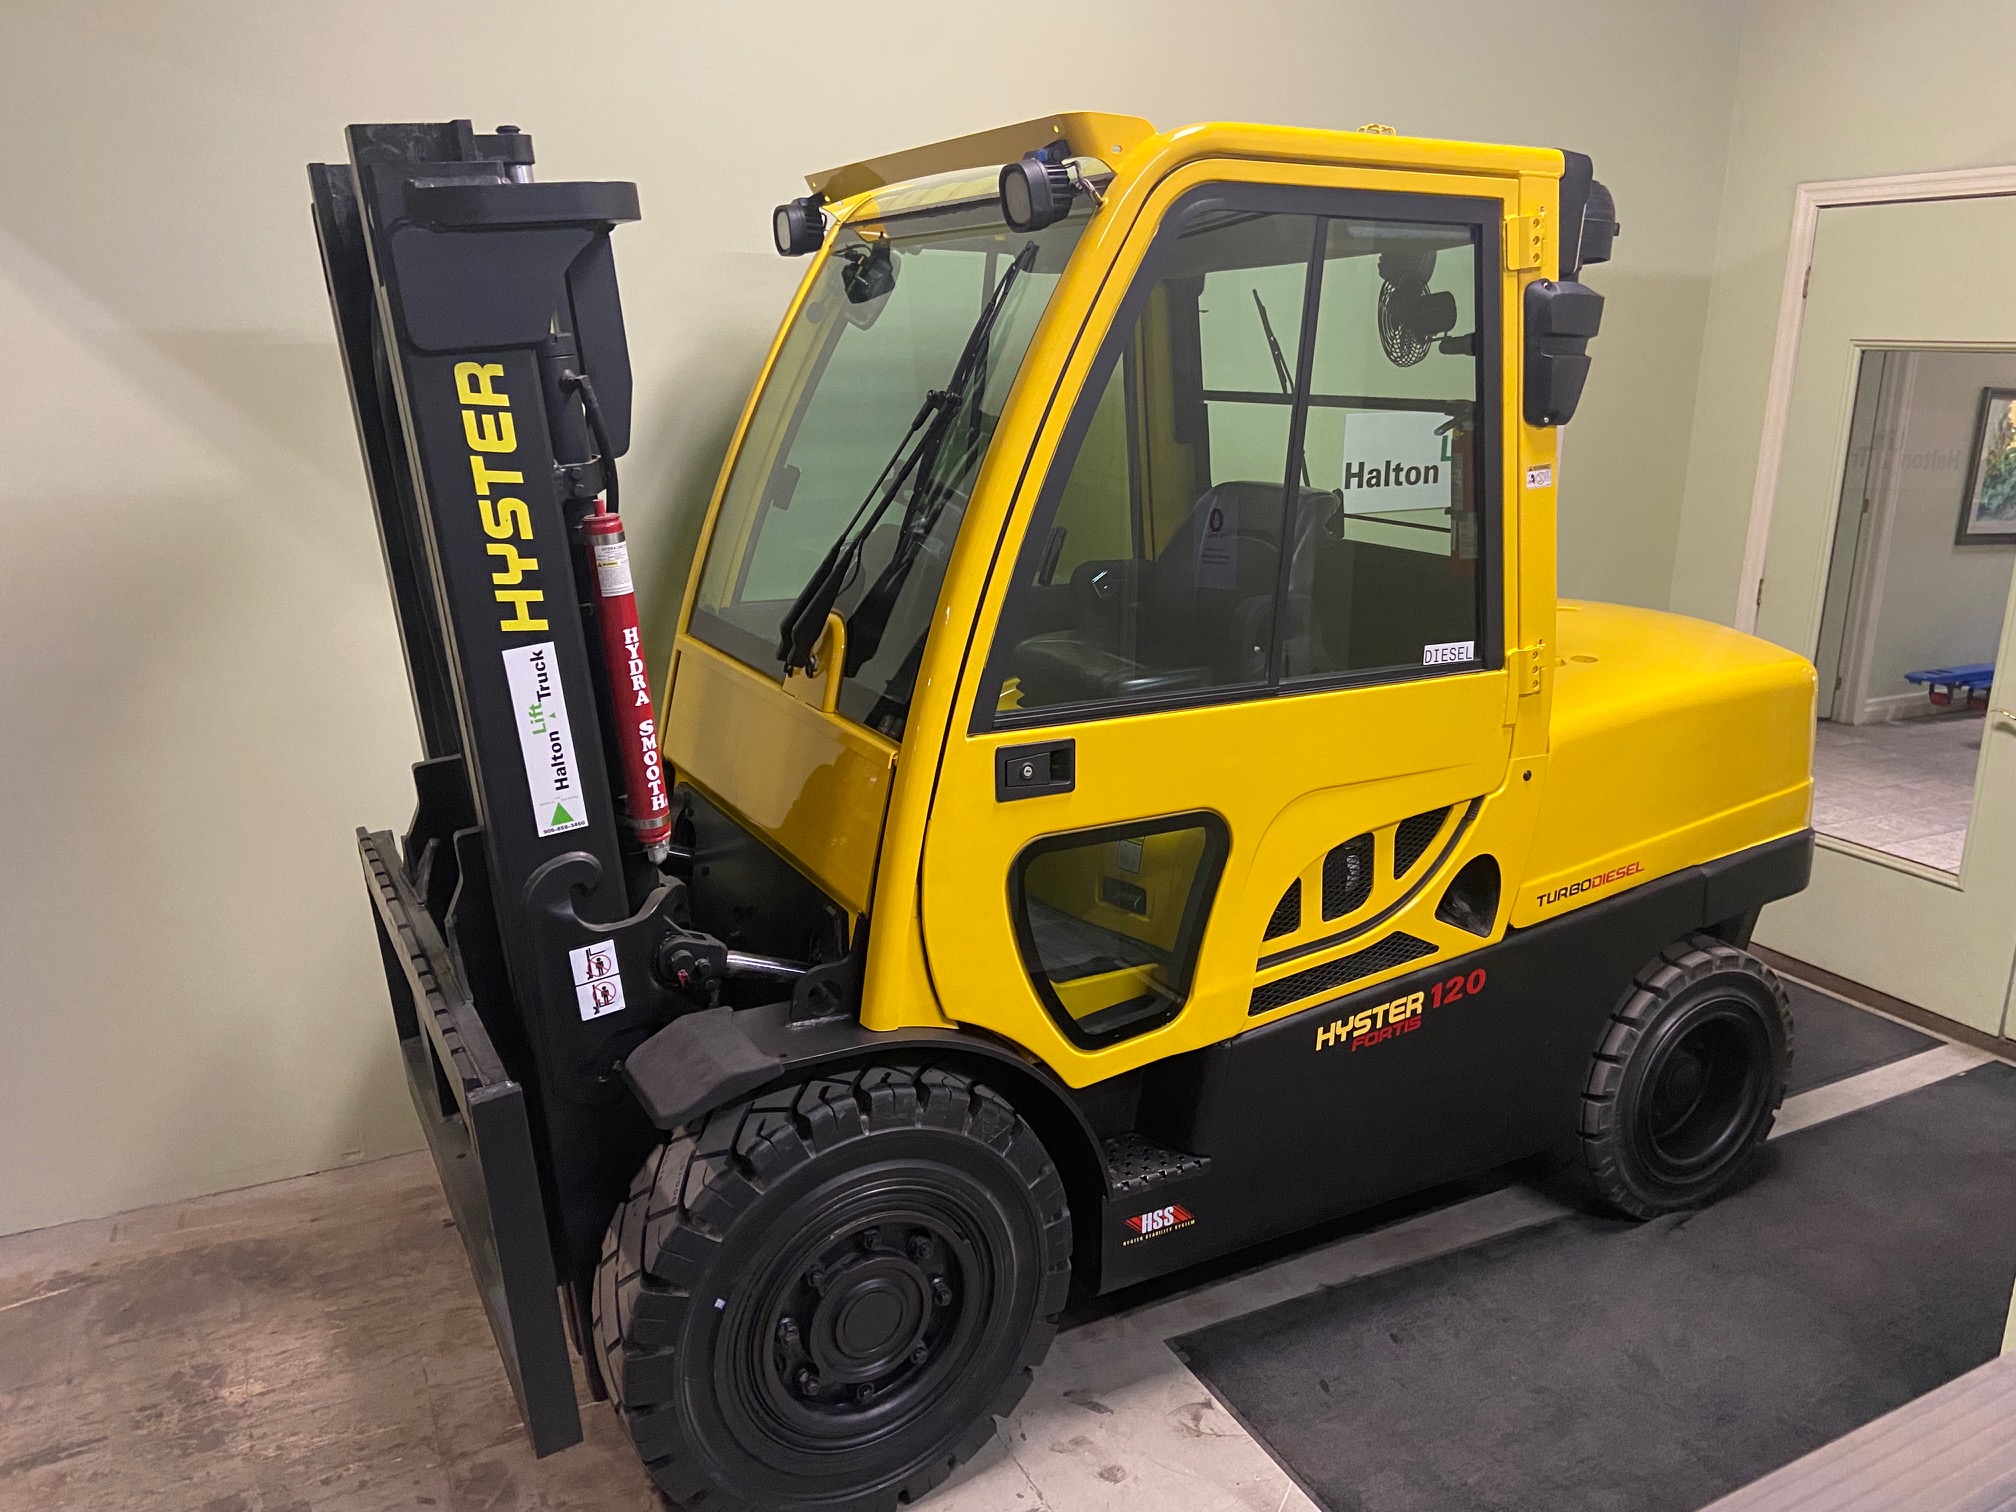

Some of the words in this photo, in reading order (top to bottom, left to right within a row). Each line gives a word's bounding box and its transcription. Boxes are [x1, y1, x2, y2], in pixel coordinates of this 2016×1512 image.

[454, 361, 549, 631] HYSTER
[1344, 461, 1439, 489] Halton
[530, 650, 551, 702] Truck
[1424, 645, 1473, 664] DIESEL
[528, 702, 547, 734] Lift
[623, 626, 650, 706] HYDRA
[639, 719, 667, 811] SMOOTH
[549, 730, 569, 791] Halton
[1537, 861, 1645, 907] TURBODIESEL
[1315, 991, 1425, 1051] HYSTER
[1430, 968, 1487, 1009] 120
[1351, 1014, 1423, 1052] FORTIS
[1141, 1206, 1174, 1234] HSS
